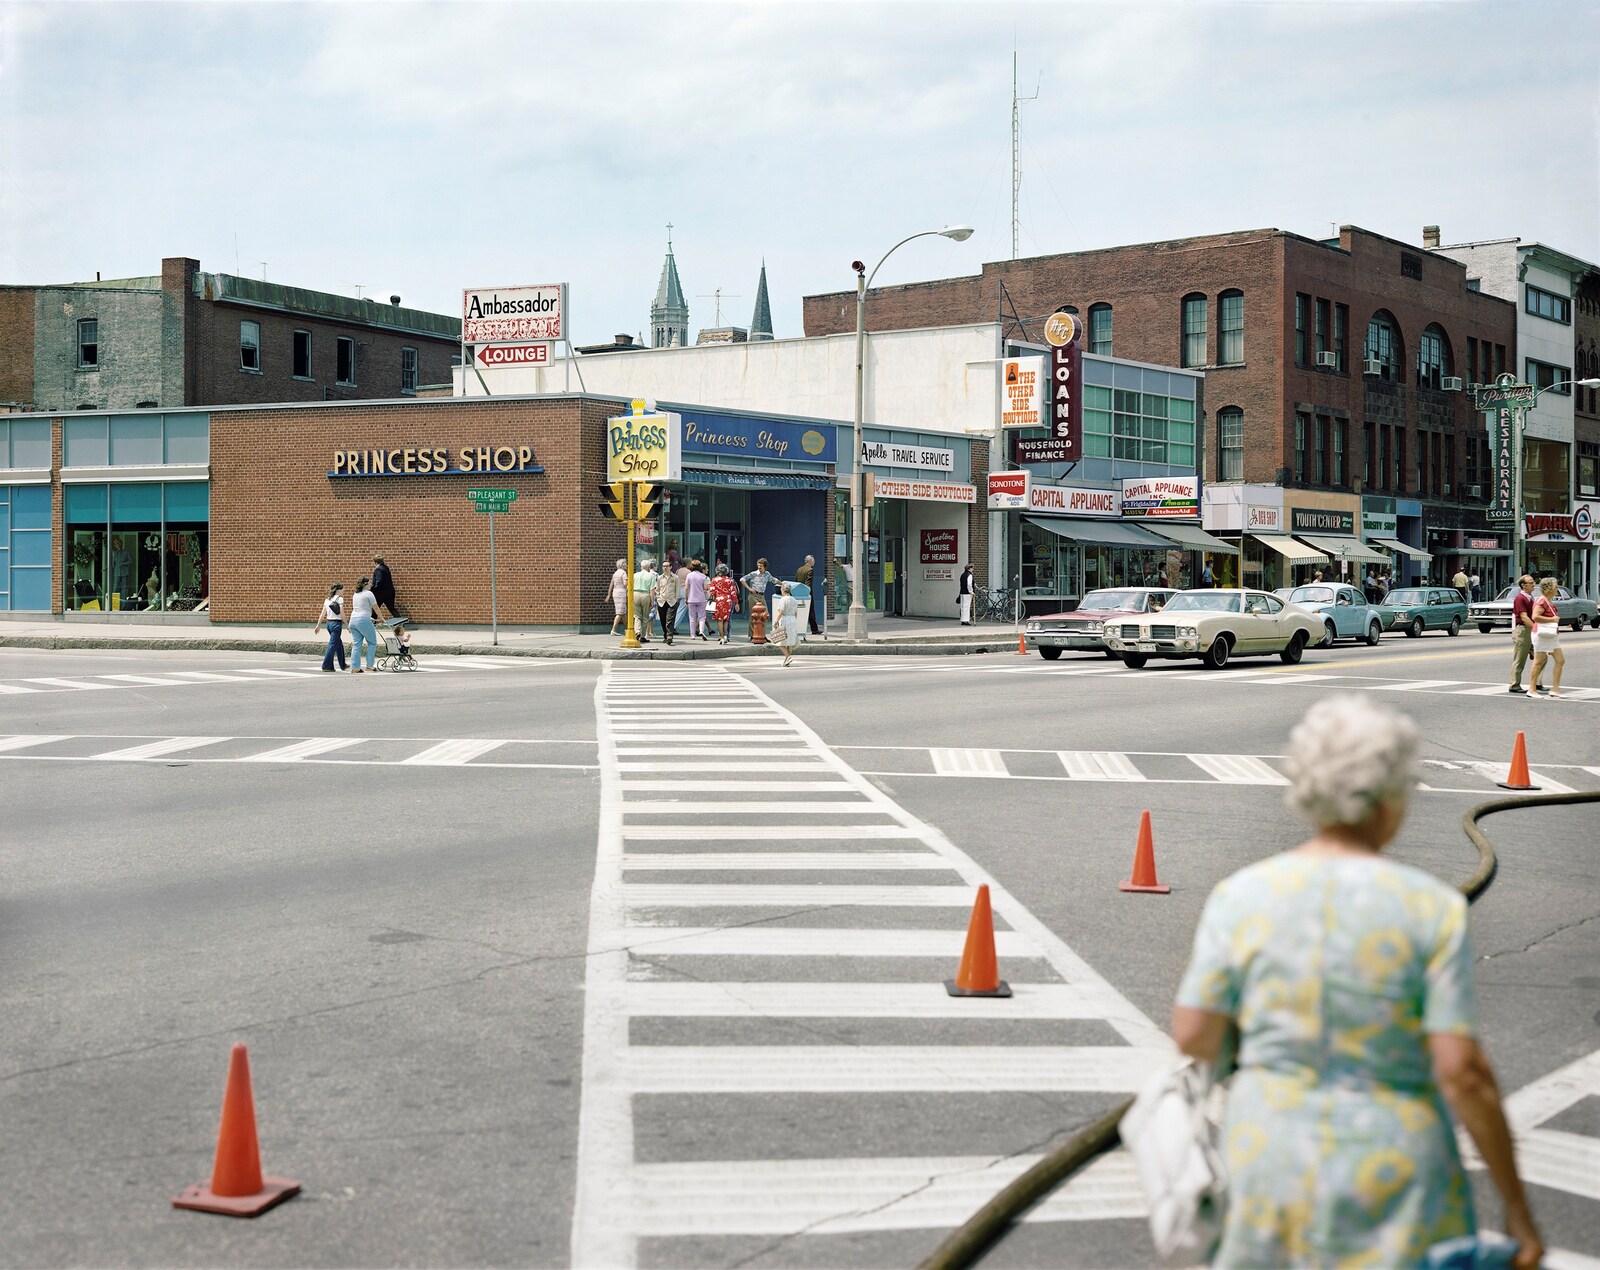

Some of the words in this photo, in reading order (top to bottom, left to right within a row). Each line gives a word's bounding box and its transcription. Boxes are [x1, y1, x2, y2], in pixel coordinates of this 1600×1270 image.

[467, 292, 557, 319] Ambassador
[467, 319, 559, 336] RESTAURANT
[485, 347, 545, 363] LOUNGE
[1019, 371, 1035, 384] THE
[1008, 385, 1034, 398] OTHER
[1056, 349, 1070, 437] LOANS
[1012, 398, 1029, 411] SIDE
[1003, 410, 1038, 425] BOUTIQUE
[685, 422, 747, 448] Princess
[756, 430, 788, 458] Shop
[1019, 440, 1072, 450] HOUSEHOLD
[334, 447, 448, 475] PRINCESS
[459, 446, 533, 472] SHOP
[862, 442, 887, 463] Apollo
[892, 449, 917, 464] TRAVEL
[921, 451, 949, 466] SERVICE
[1025, 450, 1065, 459] FINANCE
[1500, 408, 1510, 508] RESTAURANT
[619, 453, 658, 476] Shop
[881, 481, 911, 497] OTHER
[912, 483, 931, 498] SIDE
[933, 485, 973, 501] BOUTIQUE
[990, 479, 1025, 488] SONOTONE
[1124, 484, 1152, 499] CAPITAL
[1155, 482, 1193, 497] APPLIANCE
[477, 491, 506, 499] PLEASANT
[508, 491, 515, 499] ST
[1031, 489, 1065, 508] CAPITAL
[1070, 492, 1113, 511] APPLIANCE
[1296, 513, 1316, 527] YOUTH
[1316, 514, 1341, 529] CENTER
[932, 553, 956, 561] HEARING
